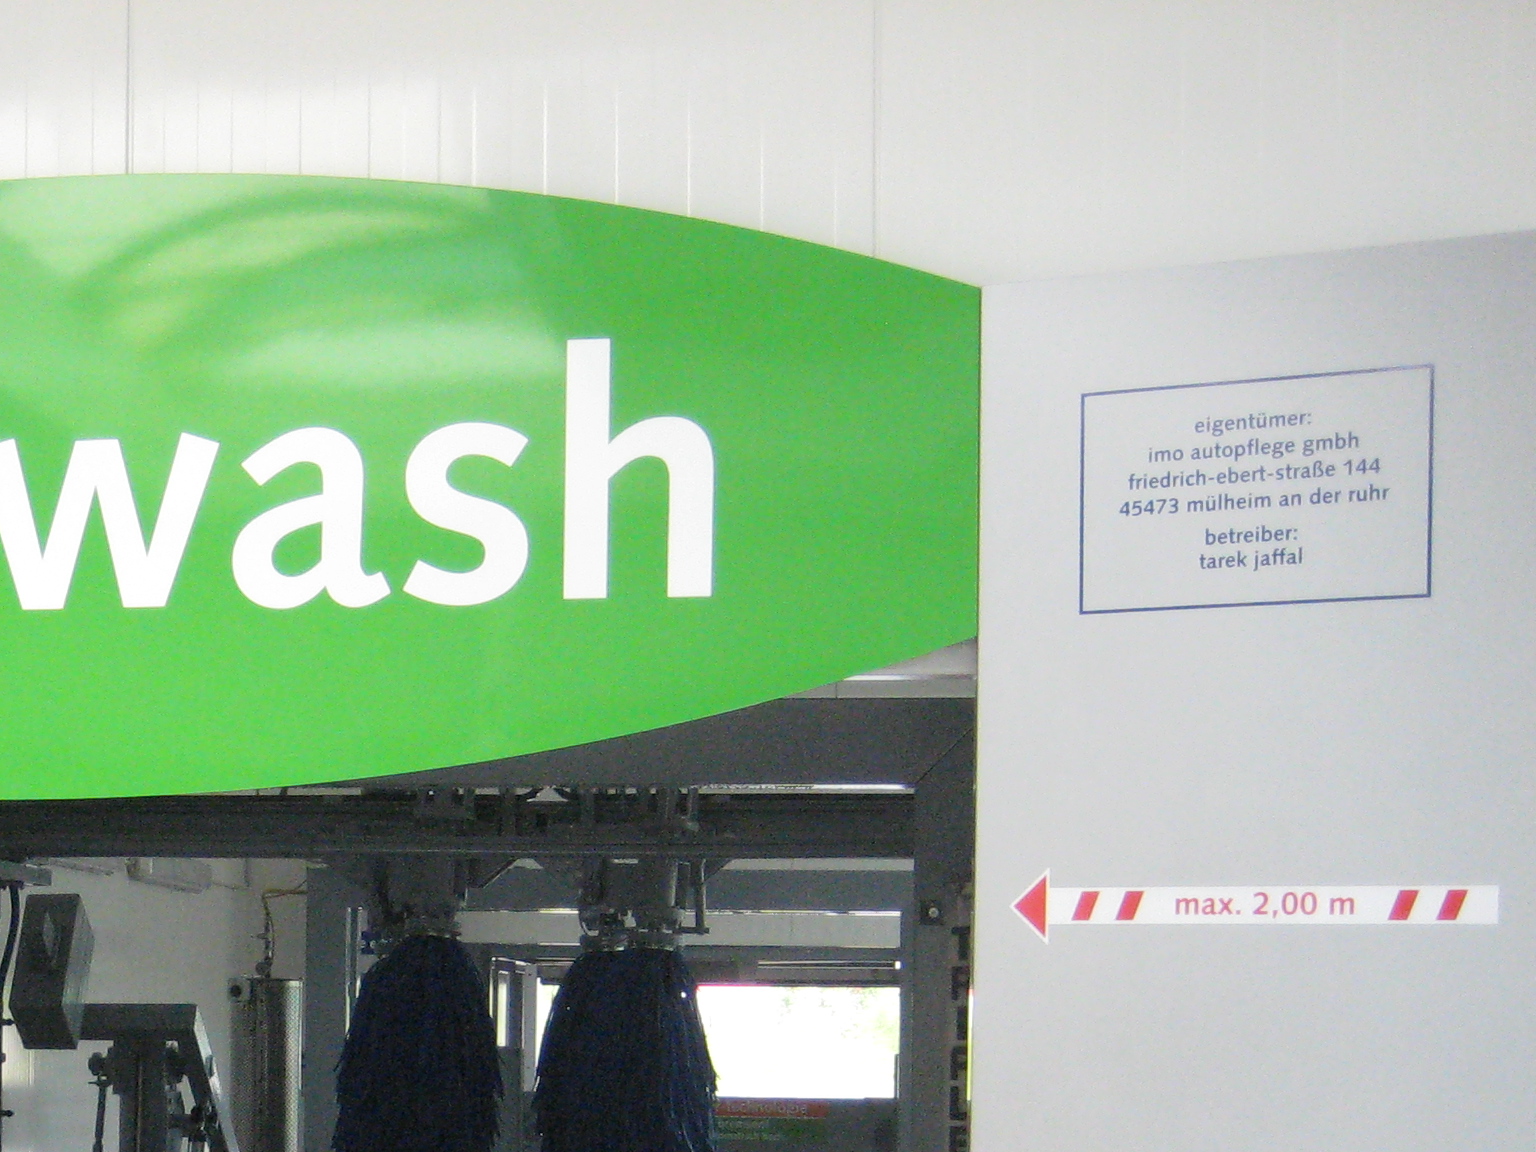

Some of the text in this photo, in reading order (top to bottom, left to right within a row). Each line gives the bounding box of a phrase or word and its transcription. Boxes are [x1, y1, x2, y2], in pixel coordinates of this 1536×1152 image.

[1195, 412, 1312, 436] eigentümer:
[1148, 433, 1359, 463] imo autopflege gmbh
[1129, 458, 1380, 490] friedrich-ebert-straße 144
[1119, 484, 1389, 517] 45473 mülheim an der ruhr
[1205, 526, 1298, 546] betreiber:
[1199, 548, 1303, 571] tarek jaffal
[1175, 892, 1355, 919] max. 2,00 m
